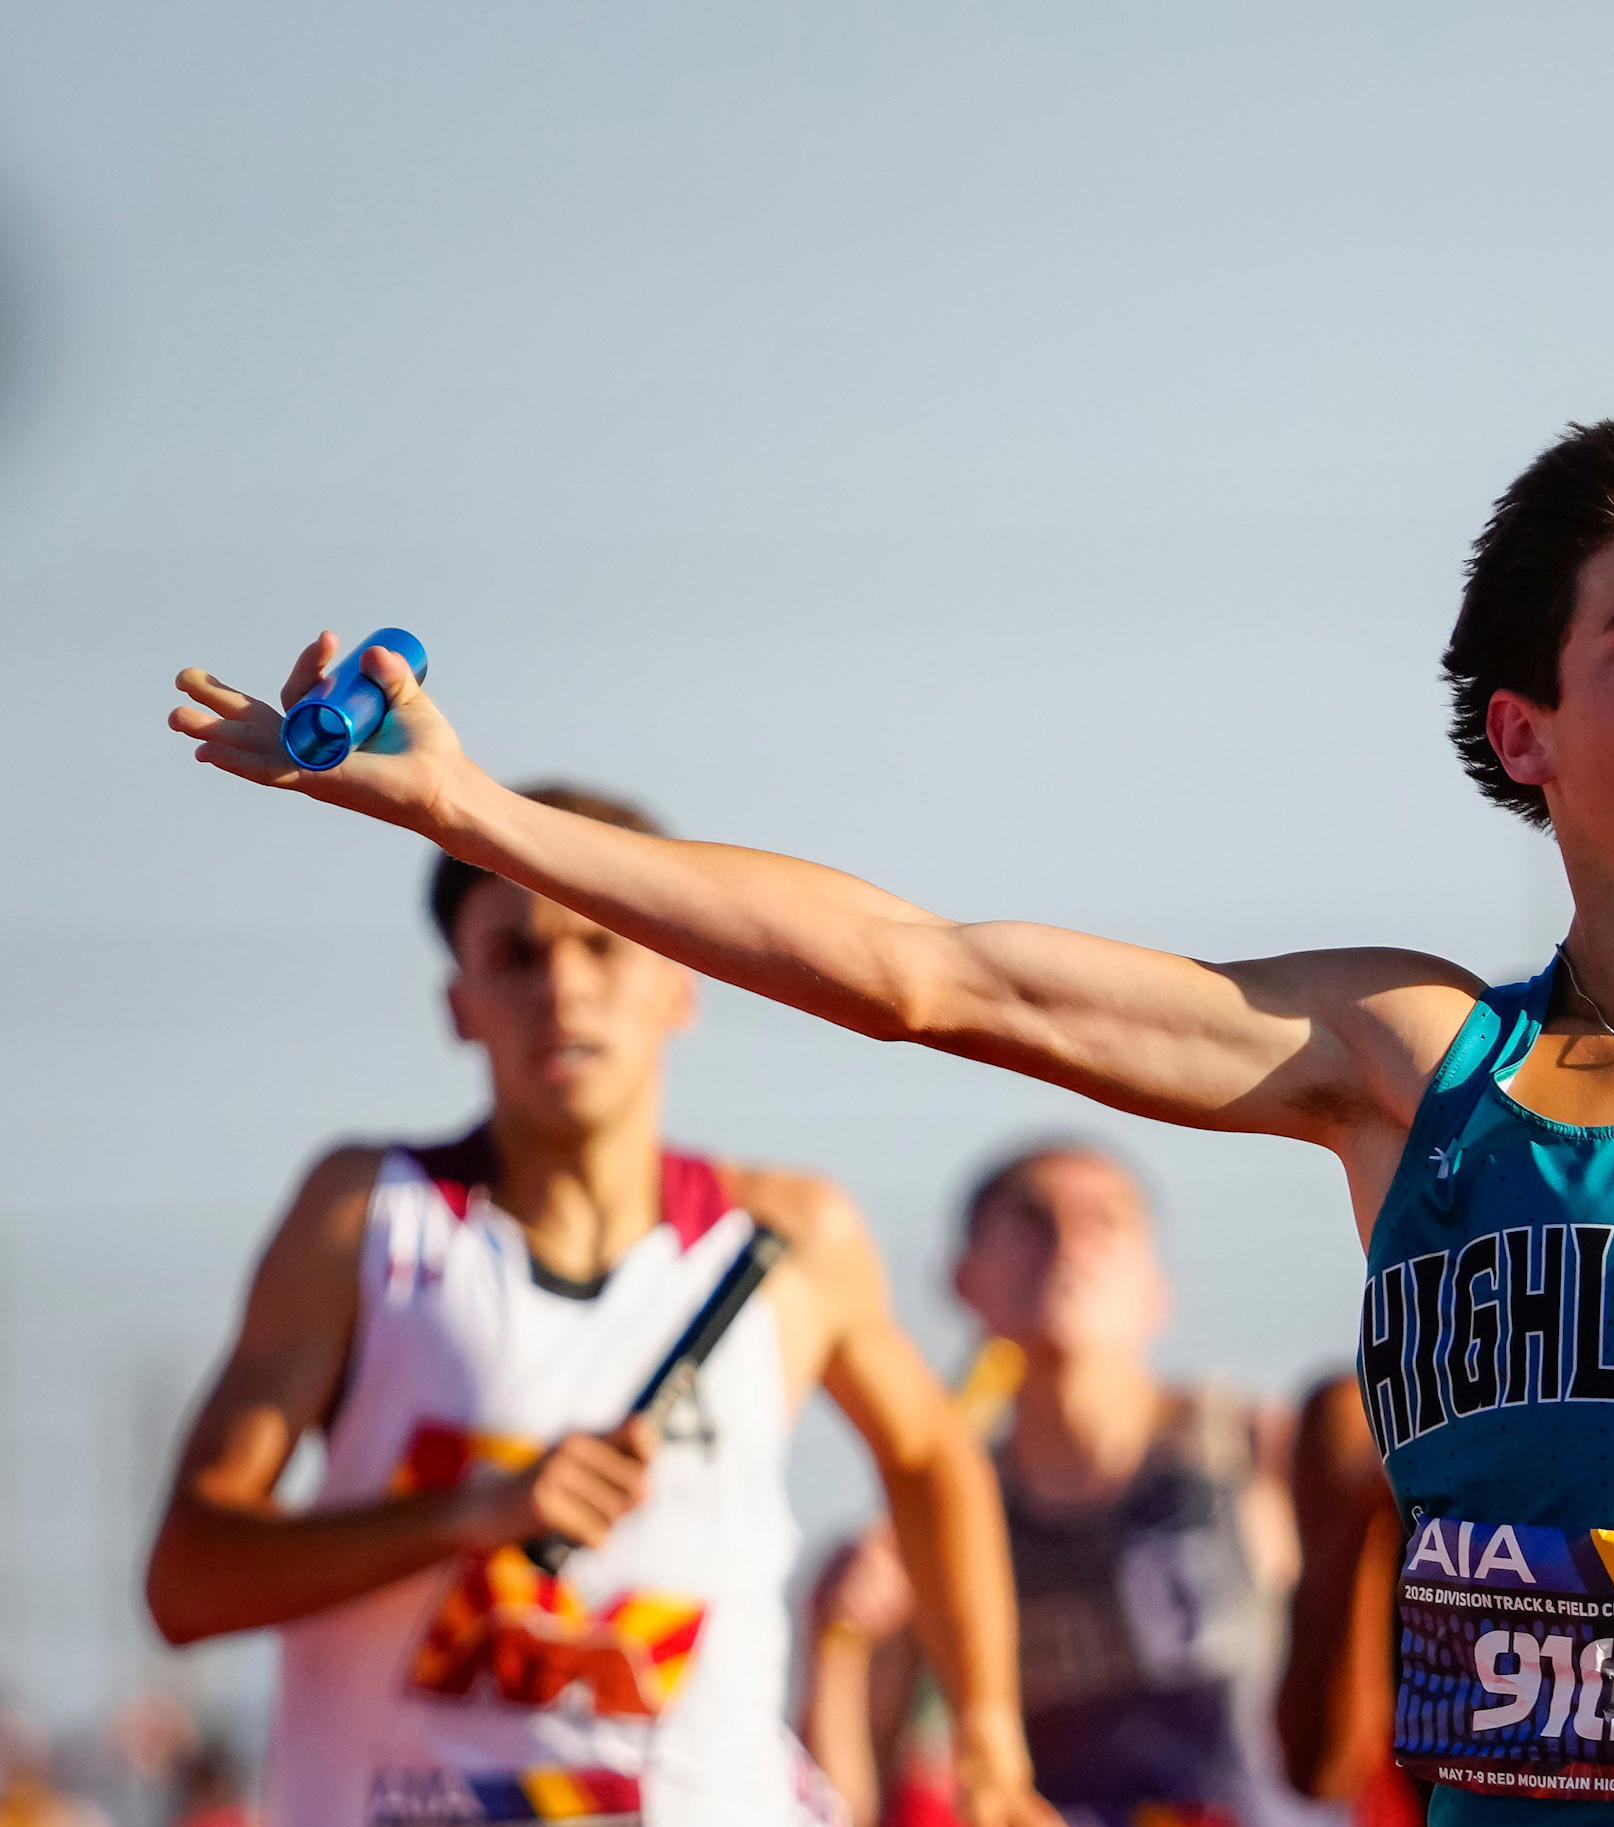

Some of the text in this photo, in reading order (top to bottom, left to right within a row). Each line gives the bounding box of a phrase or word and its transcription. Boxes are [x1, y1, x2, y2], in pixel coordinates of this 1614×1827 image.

[1407, 1517, 1537, 1584] AIA
[1404, 1585, 1433, 1602] 2026
[1435, 1589, 1493, 1608] DIVISION
[1493, 1595, 1544, 1612] TRACK
[1545, 1599, 1556, 1614] &
[1557, 1600, 1600, 1617] FIELD
[1438, 1767, 1464, 1781] MAY
[1465, 1769, 1485, 1783] 7-9
[1487, 1772, 1515, 1786] RED
[1518, 1774, 1590, 1790] MOUNTAIN
